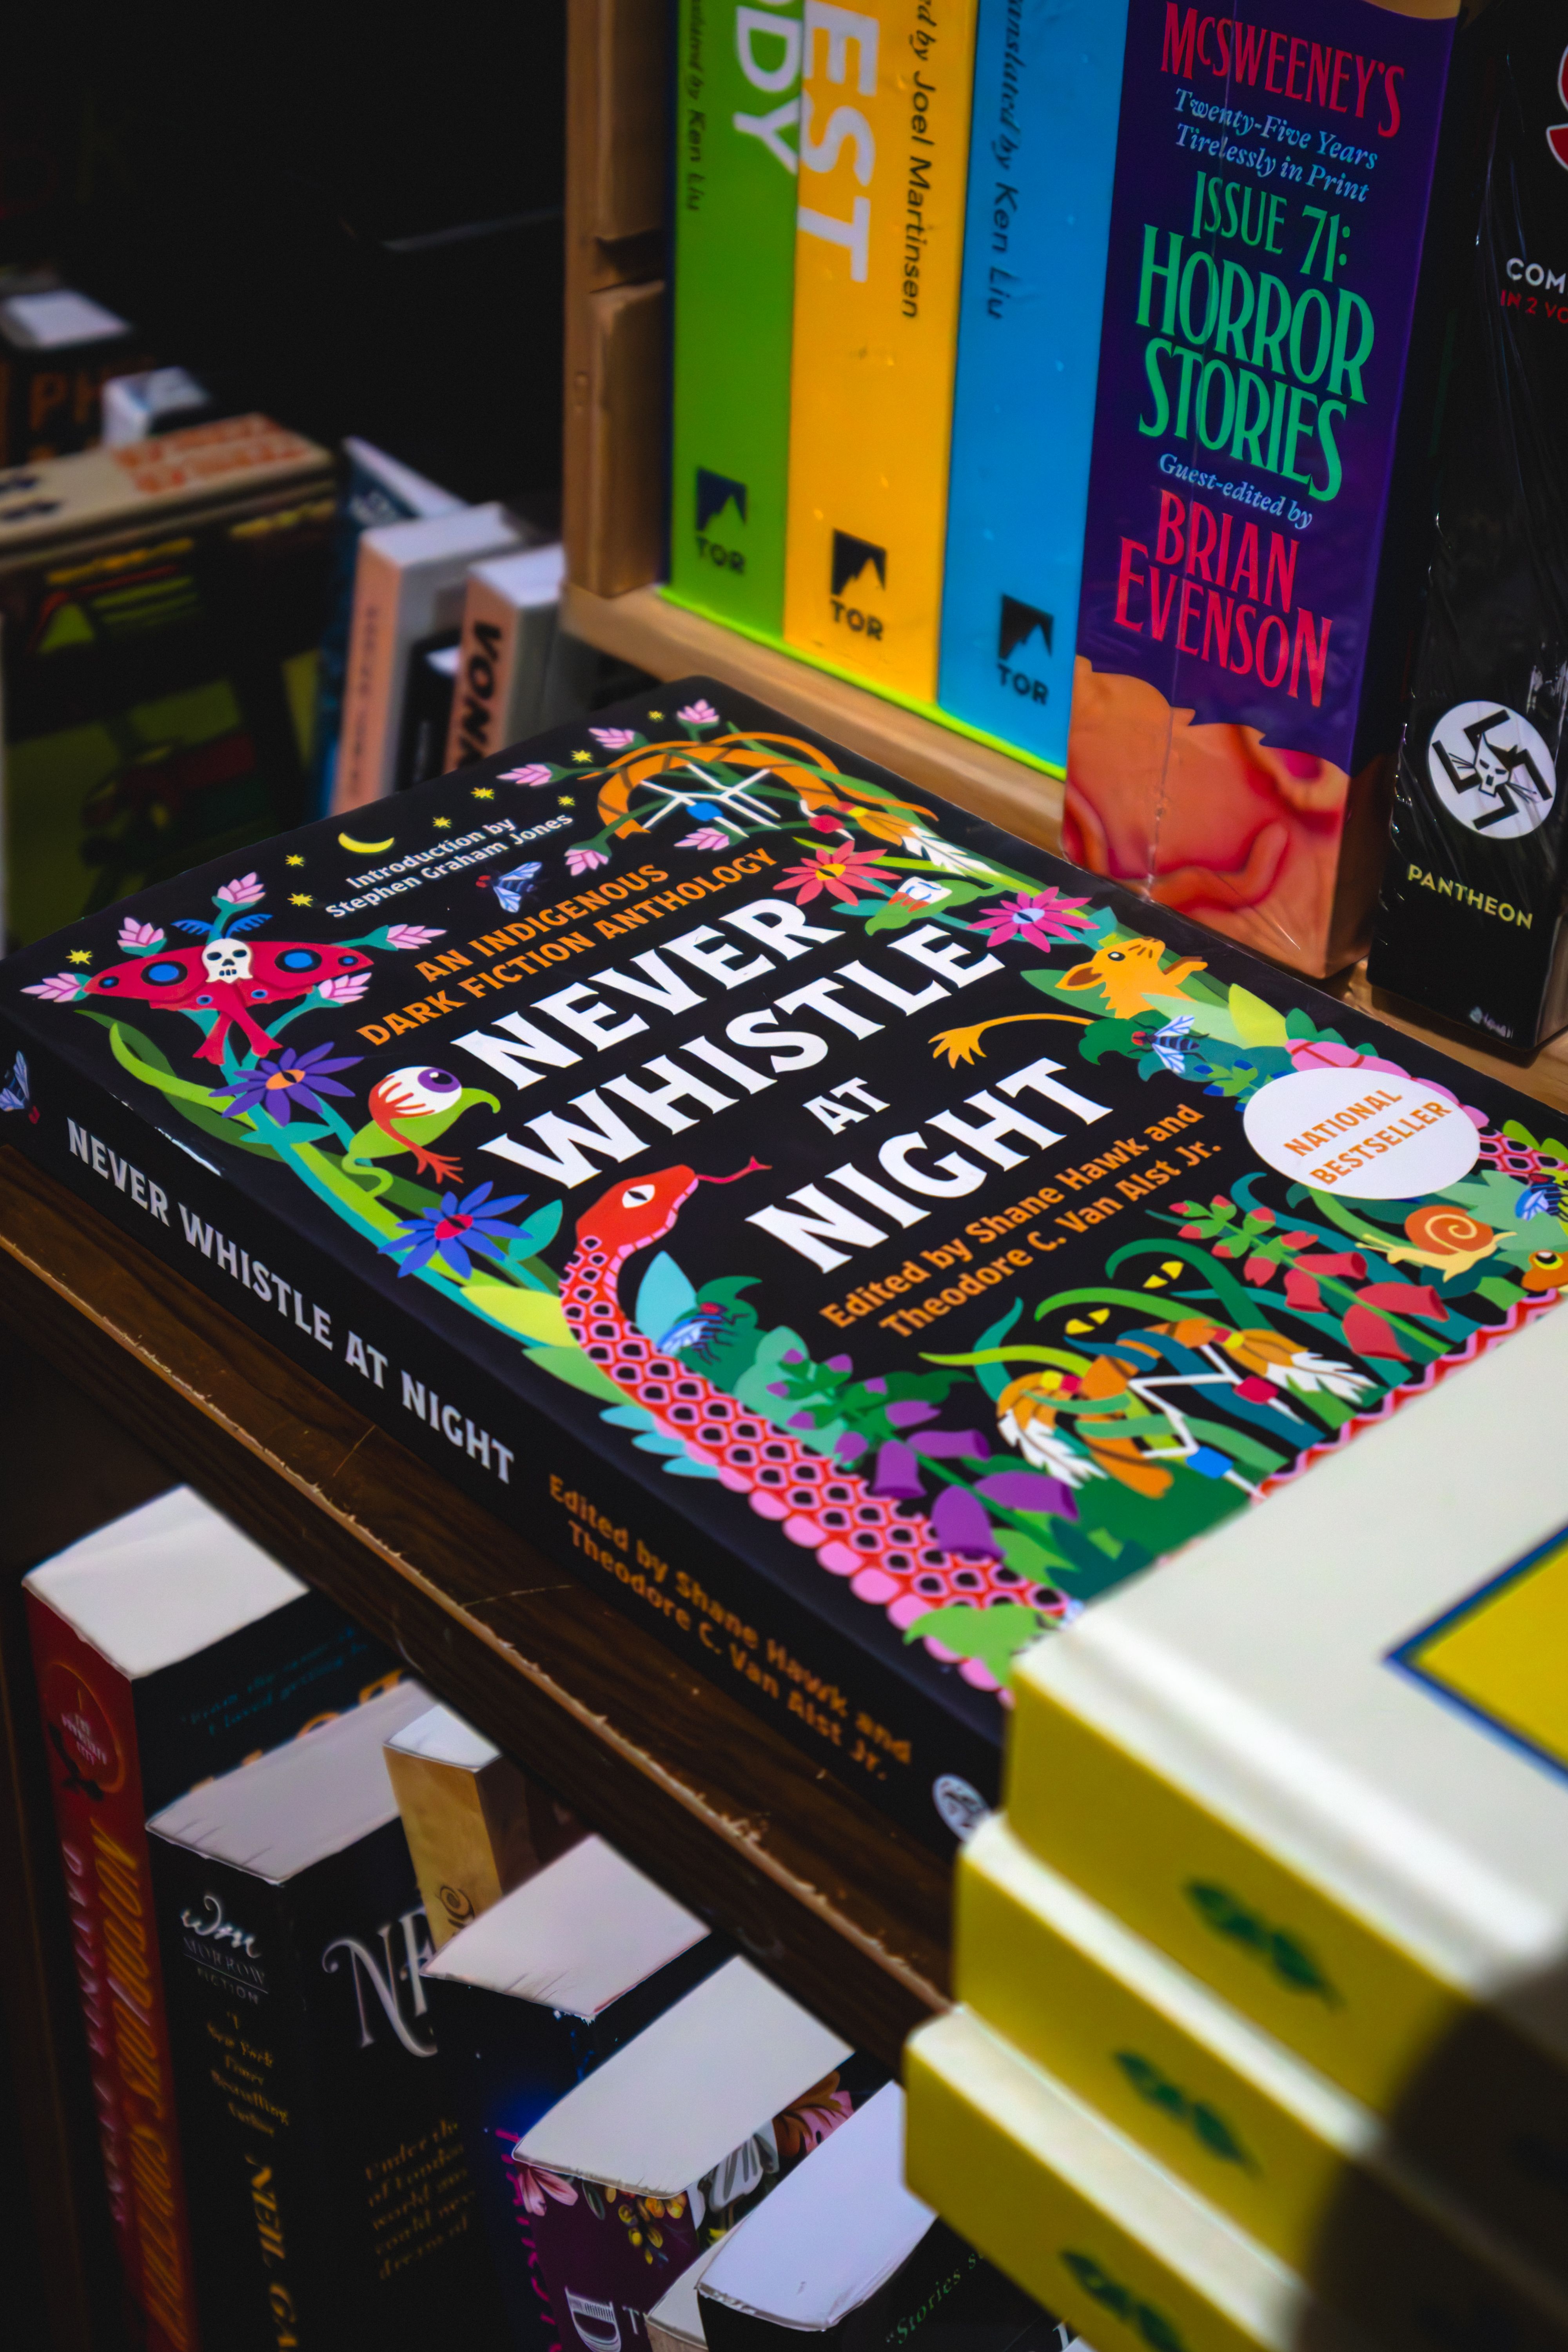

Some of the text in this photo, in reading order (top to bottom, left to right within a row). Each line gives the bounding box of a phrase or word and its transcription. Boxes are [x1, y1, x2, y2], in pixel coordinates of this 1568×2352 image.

[732, 0, 800, 175] DY
[1174, 88, 1378, 171] Twenty-Five Years
[688, 109, 705, 164] Ken
[797, 0, 880, 283] EST
[902, 0, 937, 318] d by Joel Martinsen
[991, 133, 1019, 170] by
[1176, 123, 1369, 202] Tirelessly in Print
[687, 173, 705, 212] Liu
[993, 181, 1019, 254] Ken
[1192, 171, 1350, 283] ISSUE 71:
[986, 266, 1011, 319] Liu
[1136, 223, 1375, 404] HORROR
[1501, 289, 1521, 309] IN
[1526, 295, 1539, 315] 2
[1506, 257, 1568, 295] COM
[1139, 337, 1347, 501] STORIES
[1159, 453, 1313, 530] Guest-edited by
[696, 536, 746, 575] TOR
[1155, 488, 1300, 613] BRIAN
[830, 599, 883, 642] TOR
[1113, 535, 1333, 707] EVENSON
[997, 662, 1049, 706] TOR
[325, 812, 573, 920] Stephen Graham Jones
[345, 818, 518, 891] Introduction by
[1407, 863, 1533, 929] PANTHEON
[355, 847, 779, 1047] DARK FICTION ANTHOLOGY
[414, 864, 671, 984] AN INDIGENOUS
[449, 898, 847, 1091] NEVER
[476, 923, 1006, 1190] WHISTLE
[802, 1076, 891, 1136] AT
[1282, 1089, 1403, 1157] NATIONAL
[1308, 1100, 1453, 1186] BESTSELLER
[744, 1057, 1114, 1274] NIGHT
[819, 1103, 1206, 1329] Edited by Shane Hawk and
[878, 1141, 1223, 1338] Theodore C. Van Alst Jr.
[66, 1117, 515, 1485] NEVER WHISTLE AT NIGHT
[548, 1474, 912, 1766] Edited by Shane Hawk and
[568, 1520, 887, 1781] Theodore C. Van Alst Jr.
[183, 1937, 265, 1985] MORROW
[198, 1967, 258, 2004] FICTION
[244, 2154, 286, 2269] NEIL
